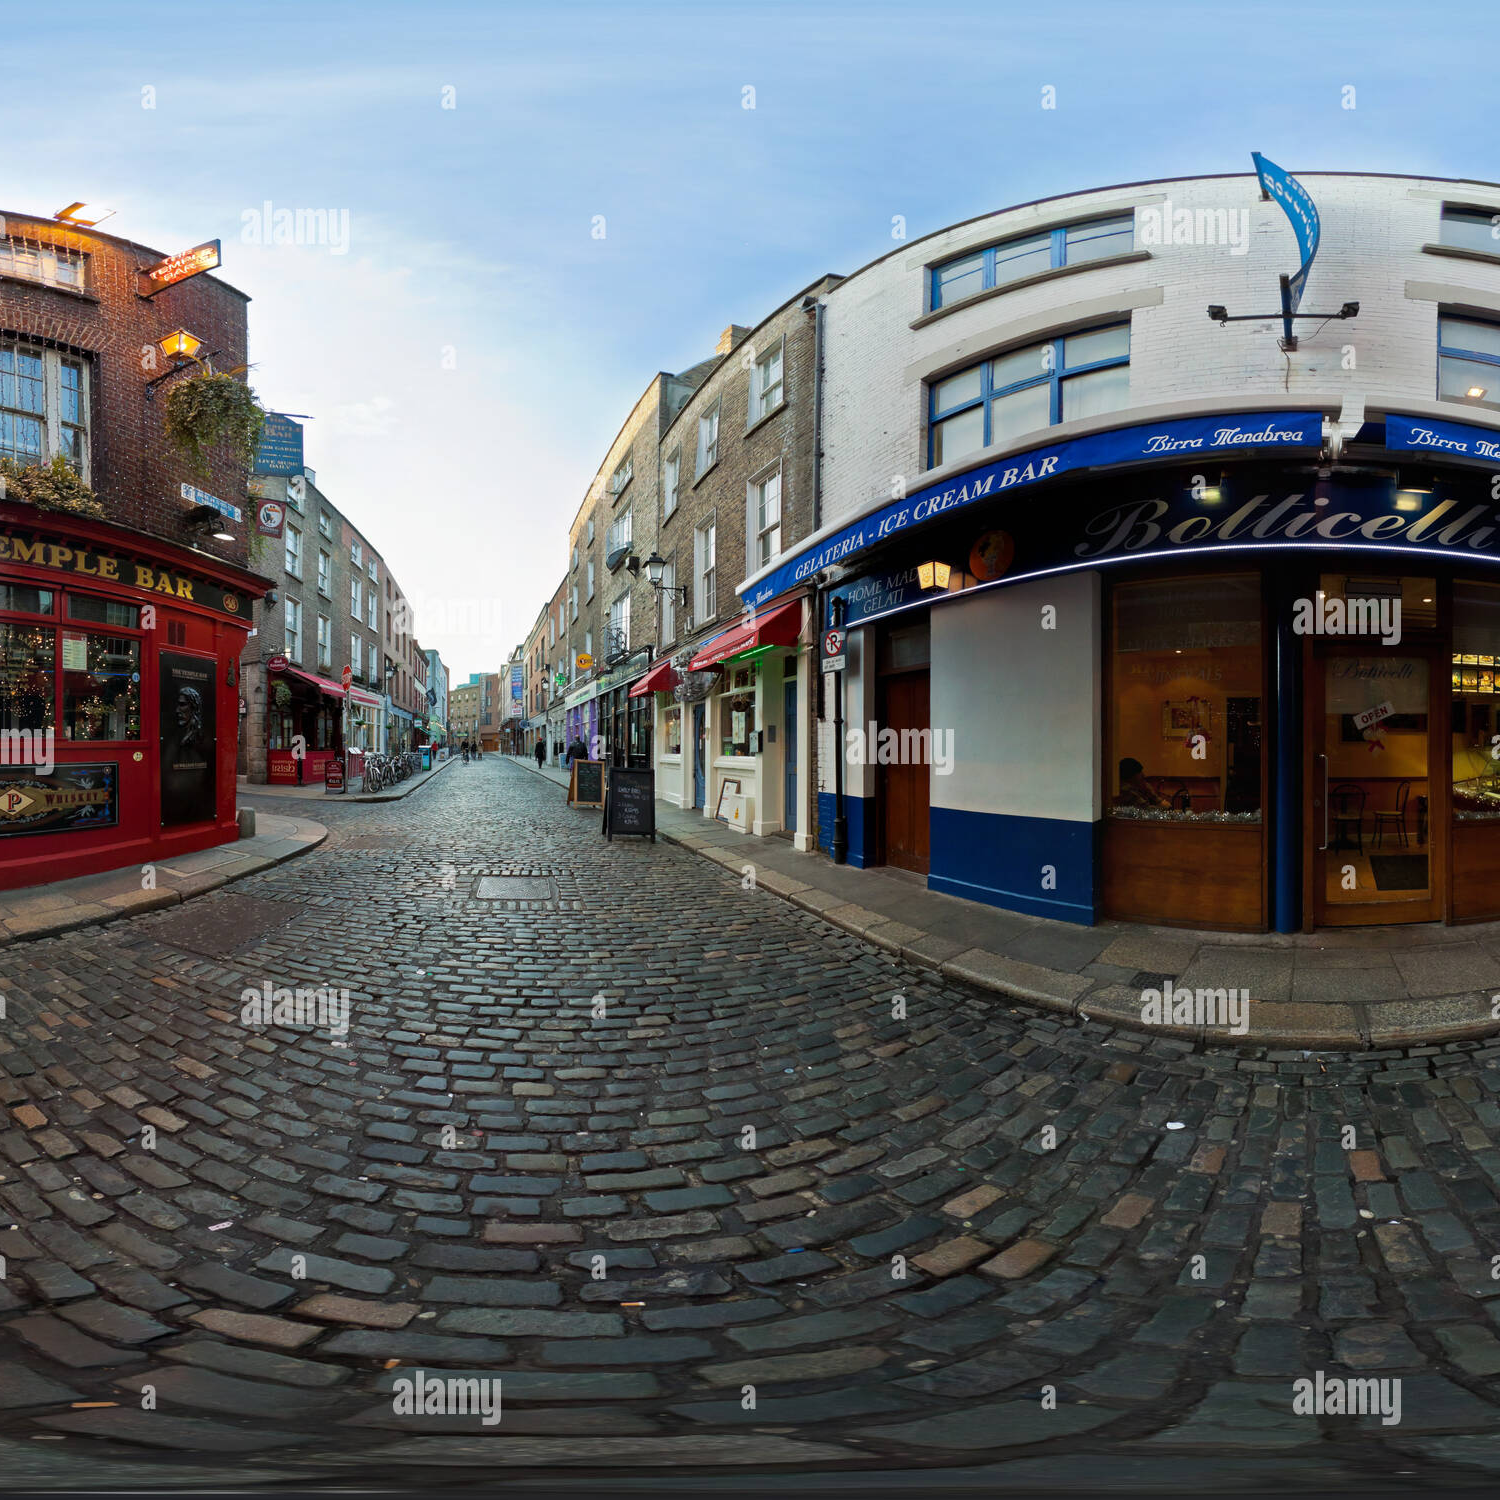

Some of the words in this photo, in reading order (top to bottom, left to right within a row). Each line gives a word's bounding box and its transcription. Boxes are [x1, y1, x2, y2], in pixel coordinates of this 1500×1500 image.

[149, 247, 215, 280] TEMPLE
[163, 262, 197, 282] BAR
[264, 428, 293, 439] BAR
[1142, 435, 1203, 454] Birra
[1209, 423, 1304, 447] Menabrea
[1405, 428, 1468, 453] Birra
[795, 530, 865, 581] GELATERIA
[877, 508, 910, 538] ICE
[913, 474, 995, 521] CREAM
[998, 455, 1059, 489] BAR
[134, 564, 195, 601] BAR
[847, 578, 883, 605] HOME
[862, 588, 905, 614] GELATI
[1360, 705, 1389, 726] OPEN
[7, 793, 22, 812] P
[44, 792, 99, 805] WHISKEY
